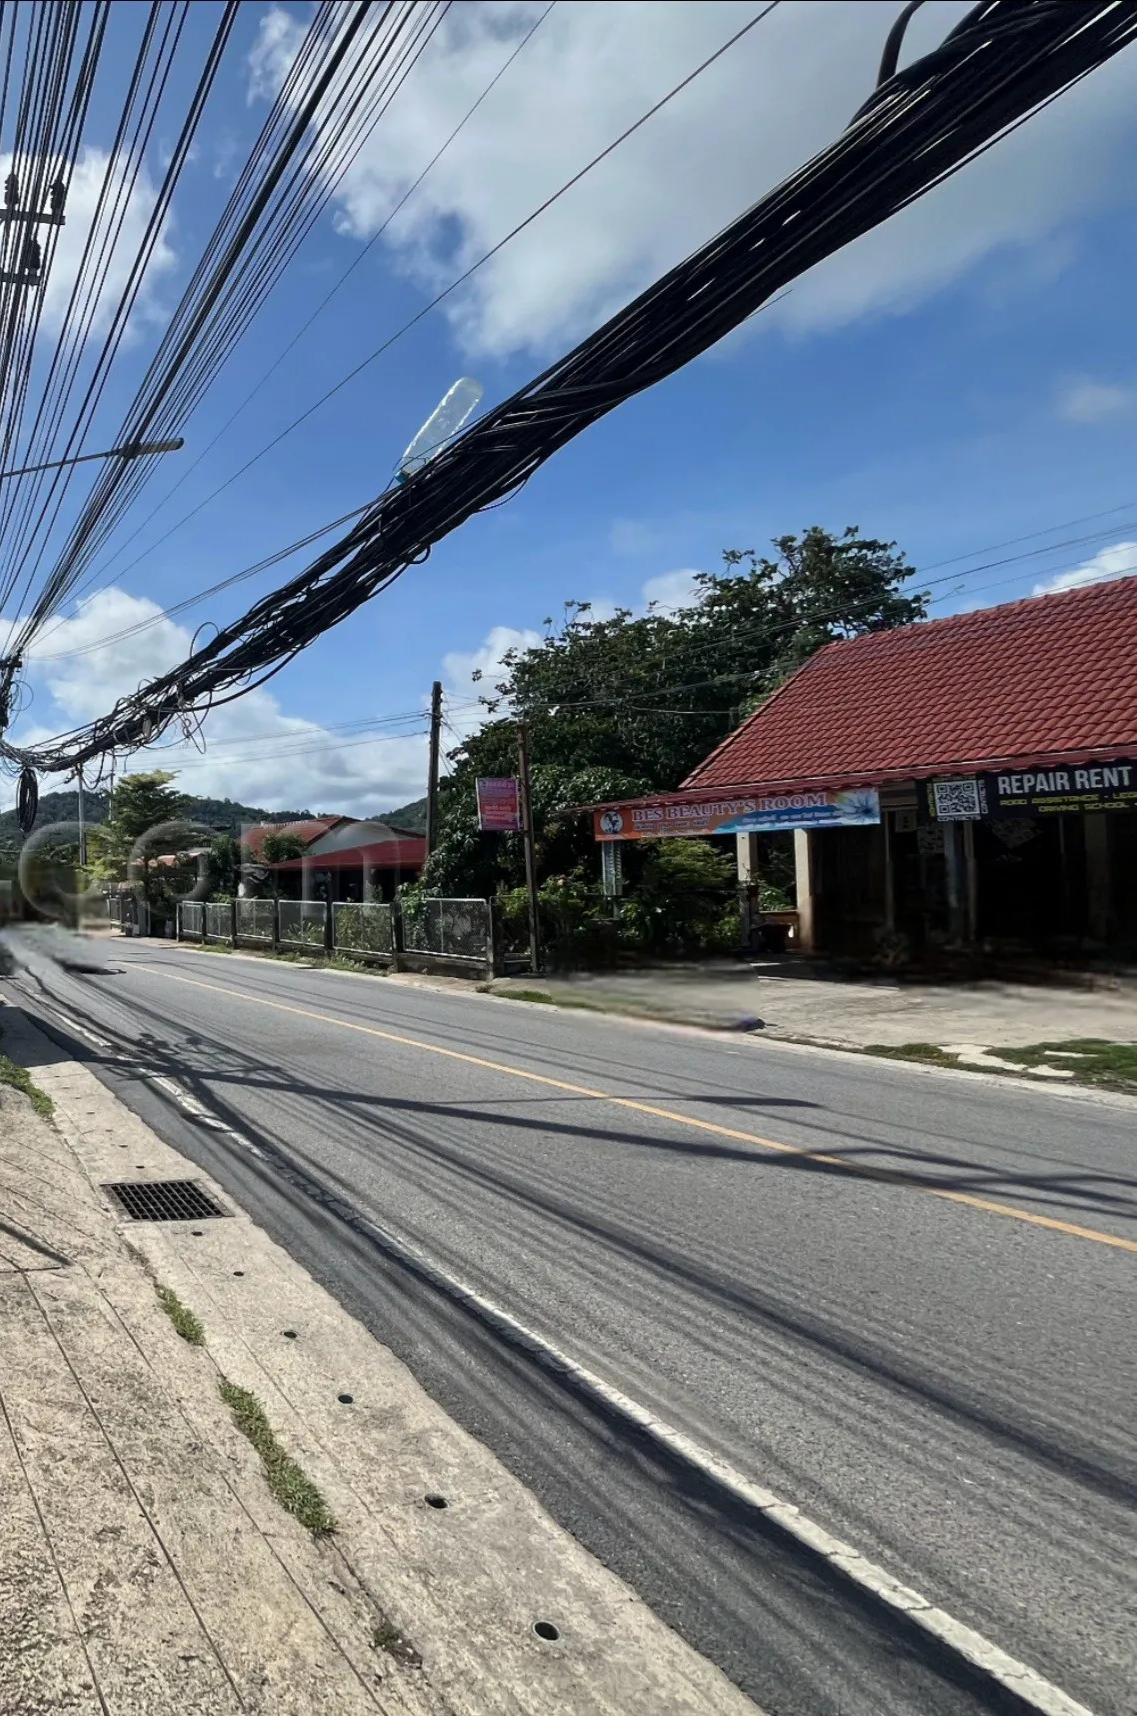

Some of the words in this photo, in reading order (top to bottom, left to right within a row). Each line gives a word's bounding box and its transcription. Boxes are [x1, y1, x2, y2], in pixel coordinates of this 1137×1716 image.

[997, 771, 1070, 795] REPAIR
[1073, 765, 1133, 790] RENT
[631, 806, 663, 821] BES
[666, 799, 756, 820] BEAUTY'S
[759, 792, 827, 811] ROOM
[1031, 793, 1100, 805] ASSISTANCE
[1038, 803, 1080, 813] DRIVING
[1083, 801, 1130, 810] SCHOOL
